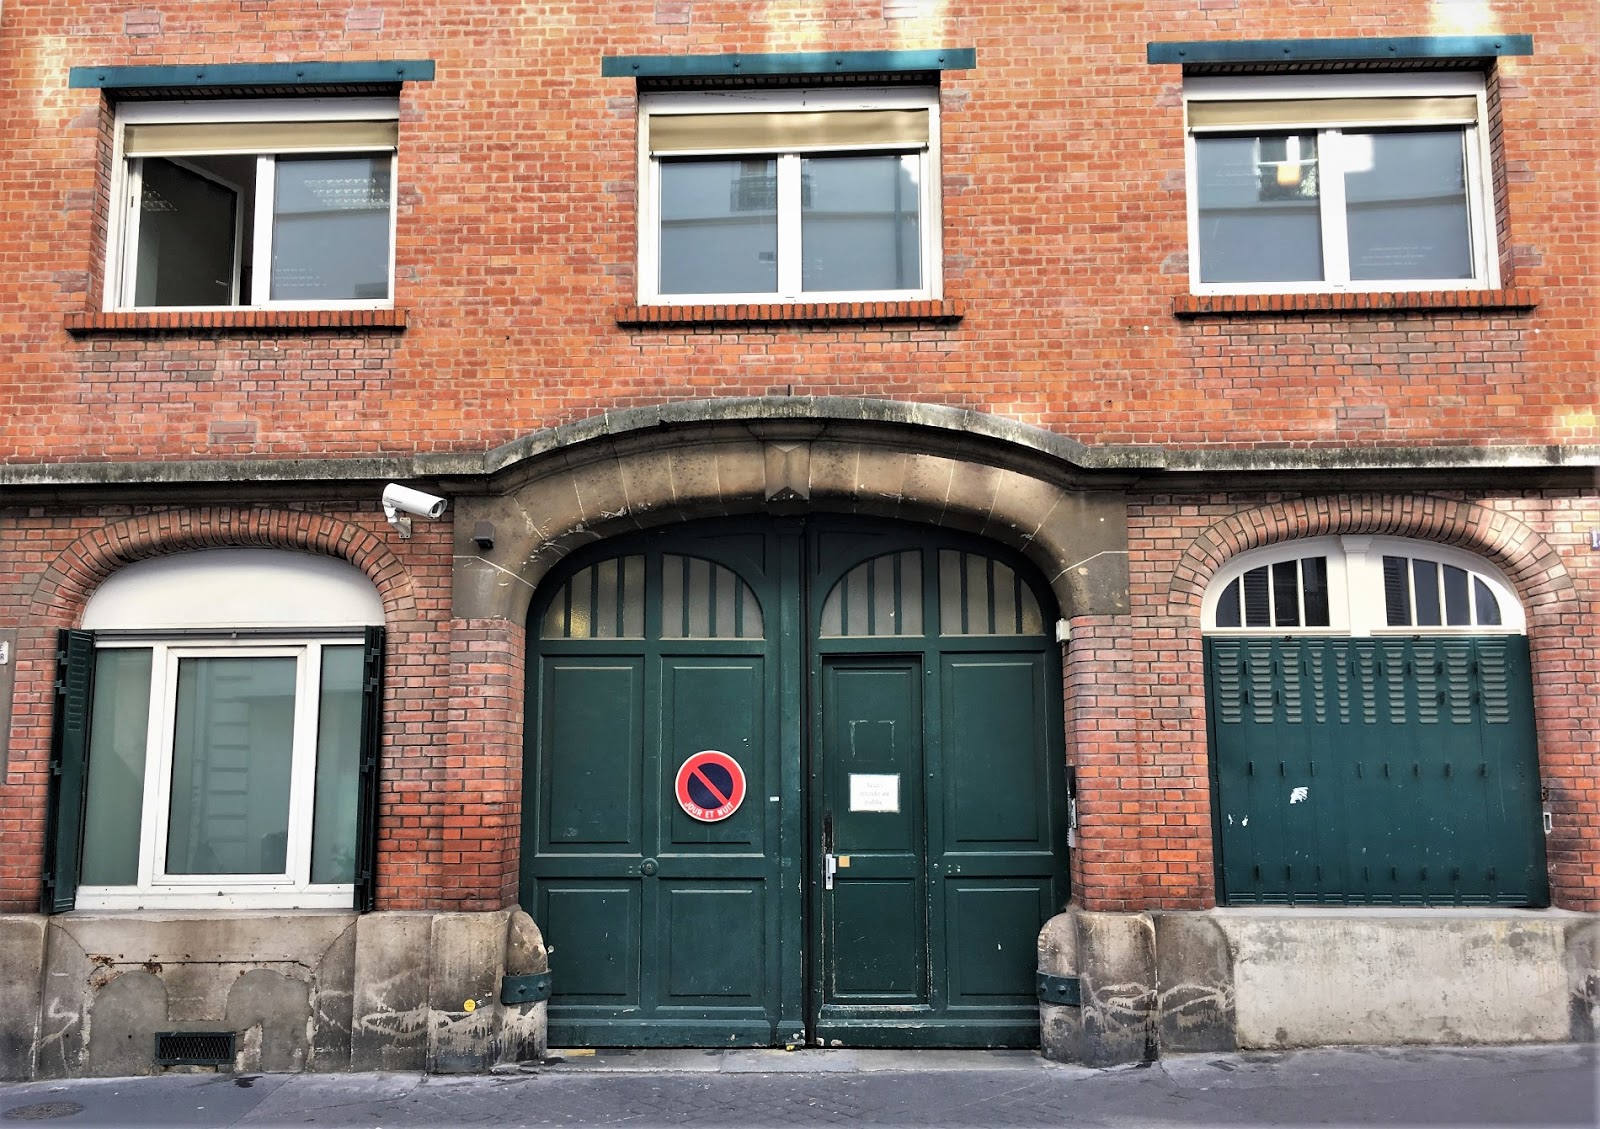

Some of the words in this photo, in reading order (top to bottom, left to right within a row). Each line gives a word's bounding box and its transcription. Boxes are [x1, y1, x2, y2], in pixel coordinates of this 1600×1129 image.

[684, 802, 703, 816] JOUR
[705, 810, 715, 818] ET
[716, 801, 734, 816] NUIT
